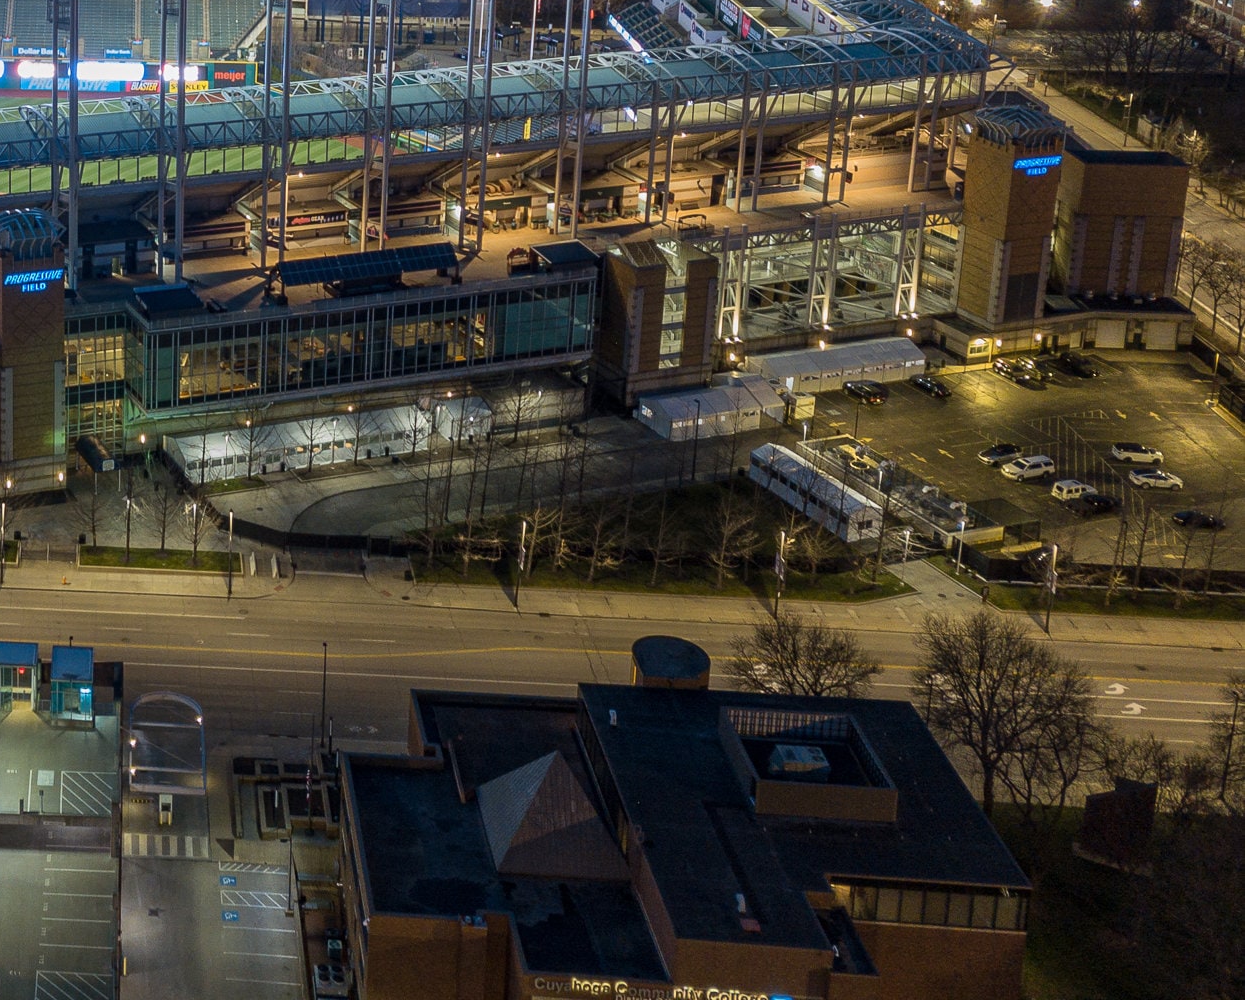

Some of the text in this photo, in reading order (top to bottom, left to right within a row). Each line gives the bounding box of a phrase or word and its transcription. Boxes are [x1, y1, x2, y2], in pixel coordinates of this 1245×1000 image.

[18, 47, 40, 55] Dollar
[214, 70, 246, 82] meijer
[131, 80, 158, 91] BLASTER
[1027, 167, 1047, 176] FIELD
[4, 268, 64, 286] PROGRESSIVE
[22, 282, 46, 293] FIELD
[534, 977, 611, 995] Cuyahoga
[615, 981, 703, 1000] Community
